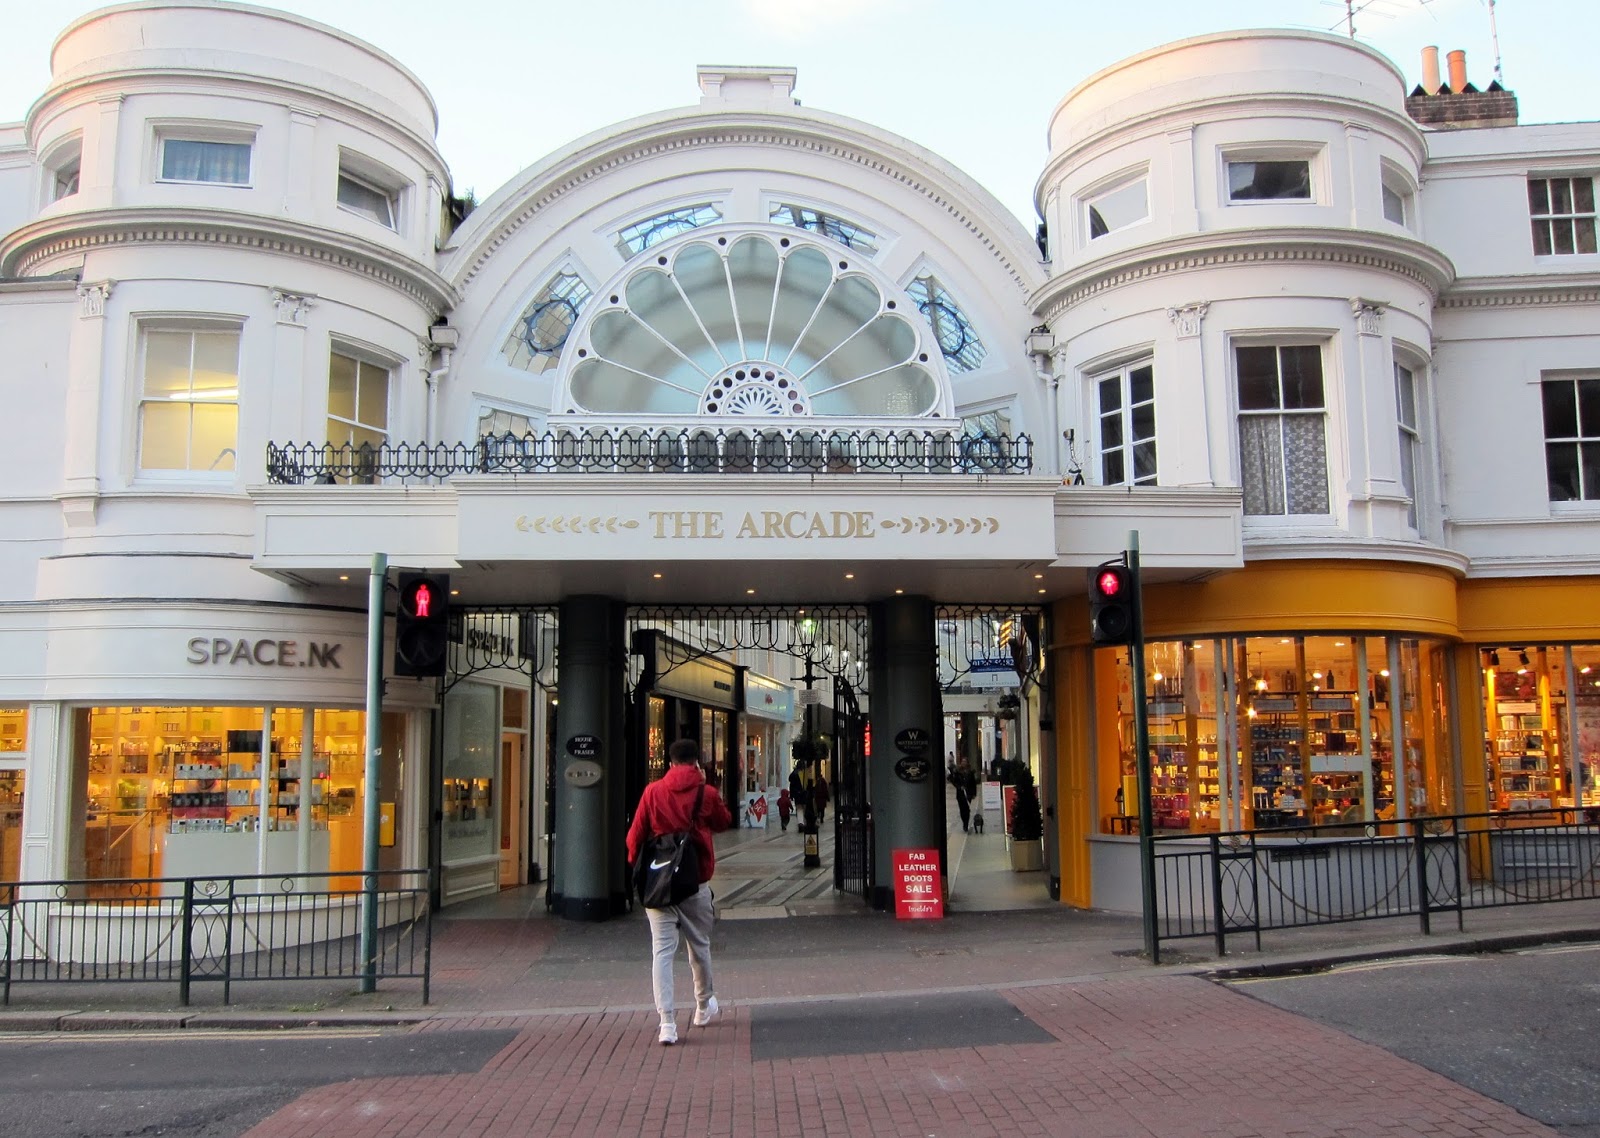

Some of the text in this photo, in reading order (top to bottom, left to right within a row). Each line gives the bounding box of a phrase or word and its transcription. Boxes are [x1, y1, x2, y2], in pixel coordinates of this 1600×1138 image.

[648, 511, 875, 539] THE ARCADE
[186, 636, 342, 669] SPACE.NK
[907, 731, 919, 740] W
[898, 864, 937, 872] LEATHER
[905, 884, 933, 893] SALE
